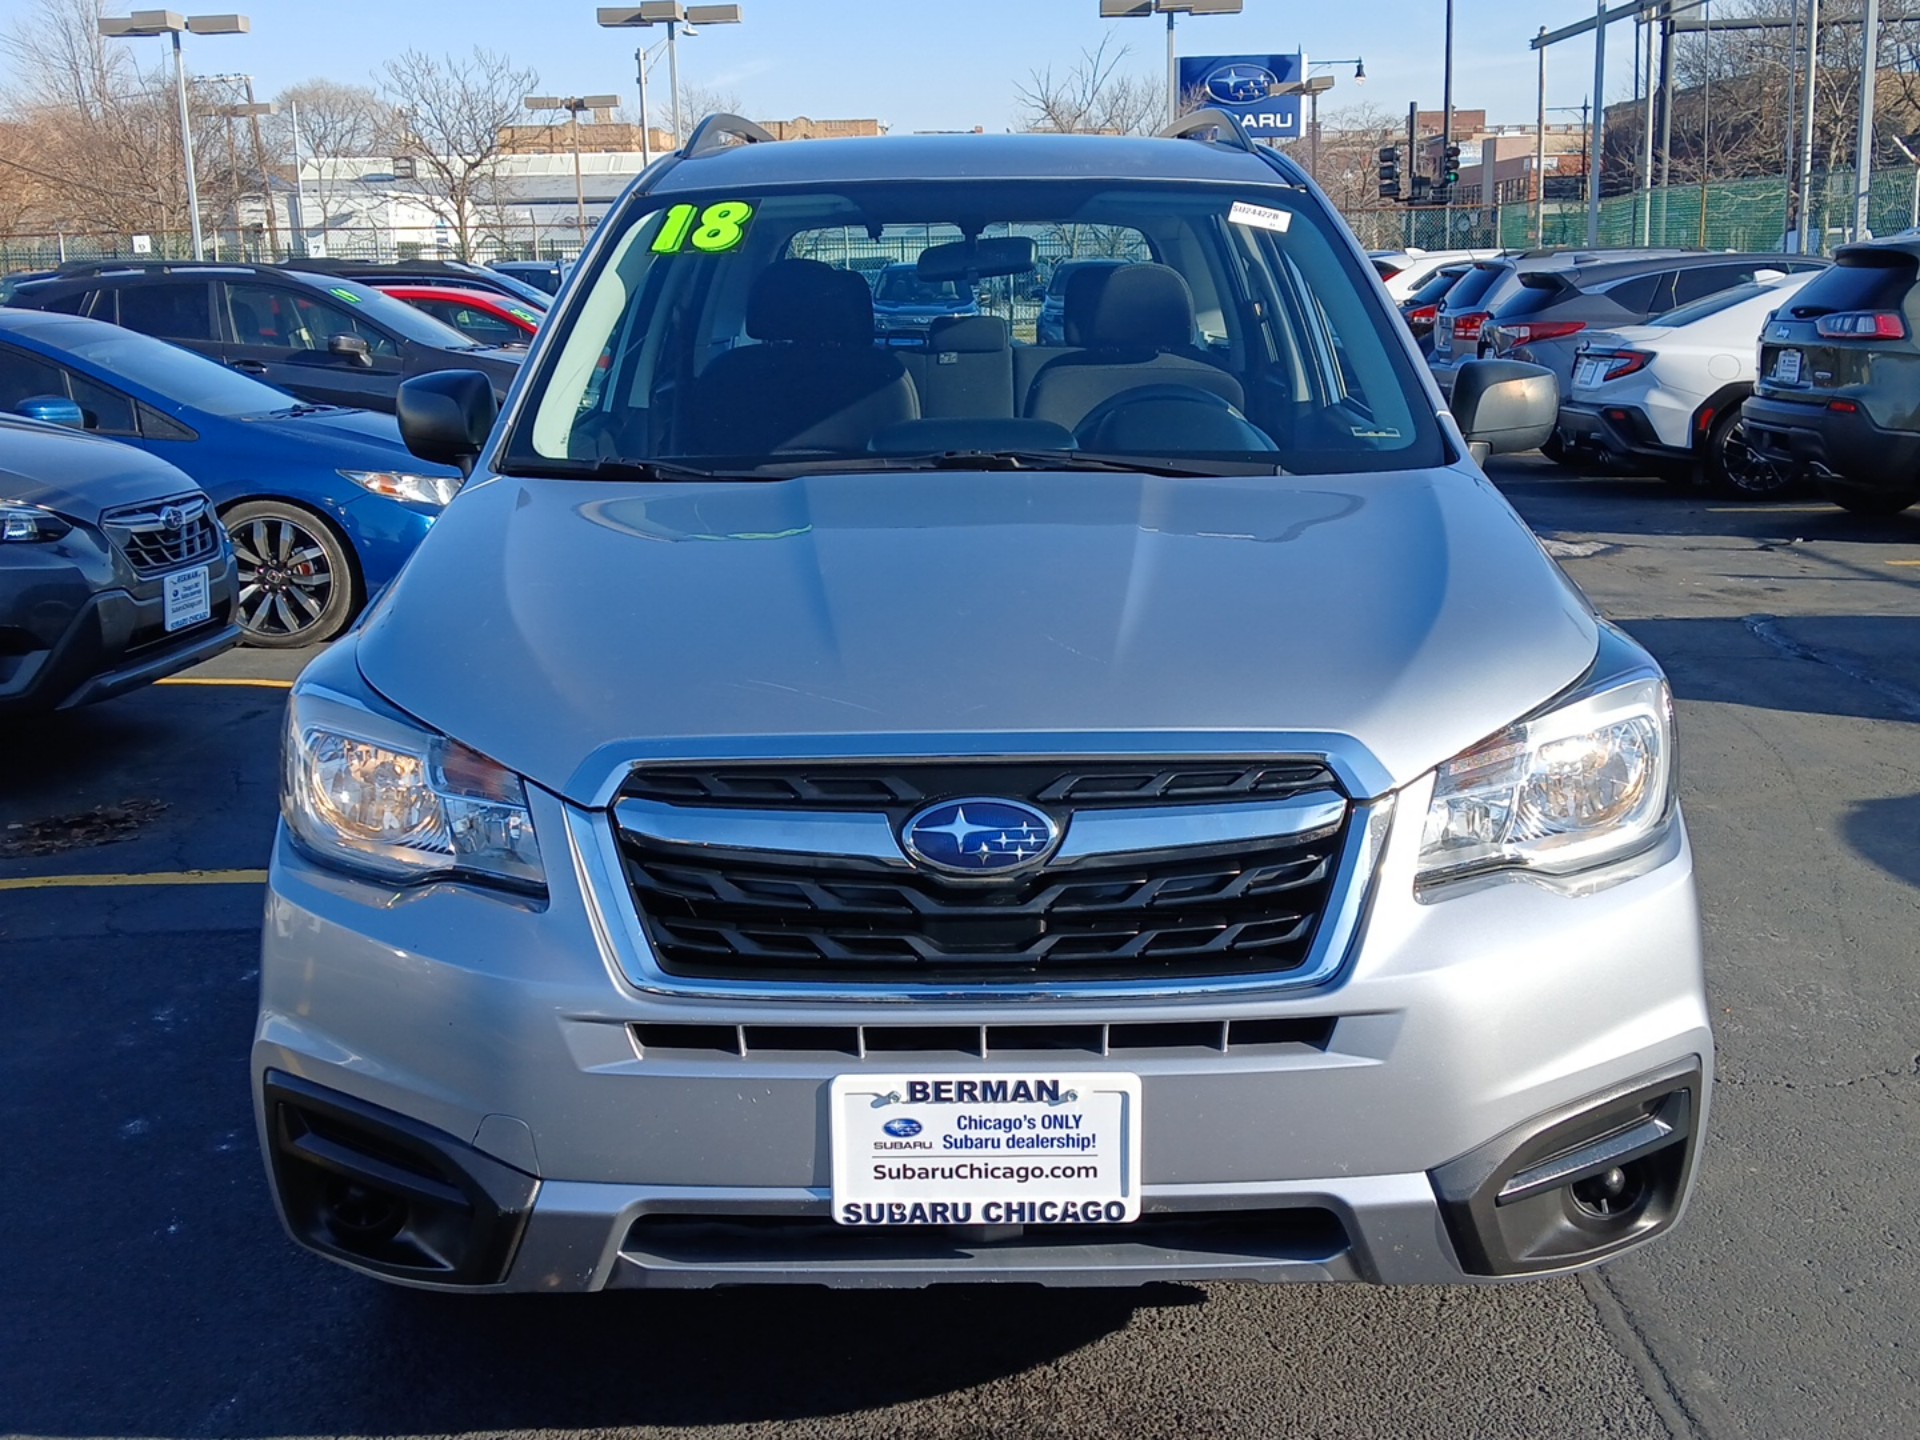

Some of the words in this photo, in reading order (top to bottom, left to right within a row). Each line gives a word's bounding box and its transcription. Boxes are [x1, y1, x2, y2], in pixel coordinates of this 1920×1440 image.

[651, 201, 752, 252] 18
[907, 1080, 1060, 1103] BERMAN
[956, 1114, 1036, 1133] Chicago's
[1041, 1114, 1083, 1130] ONLY
[873, 1141, 933, 1150] SUBARU
[942, 1134, 1001, 1150] Subaru
[1005, 1133, 1096, 1151] dealership!
[873, 1163, 1098, 1183] SubaruChicago.com
[842, 1201, 972, 1224] SUBARU
[981, 1200, 1126, 1223] CHICAGO
